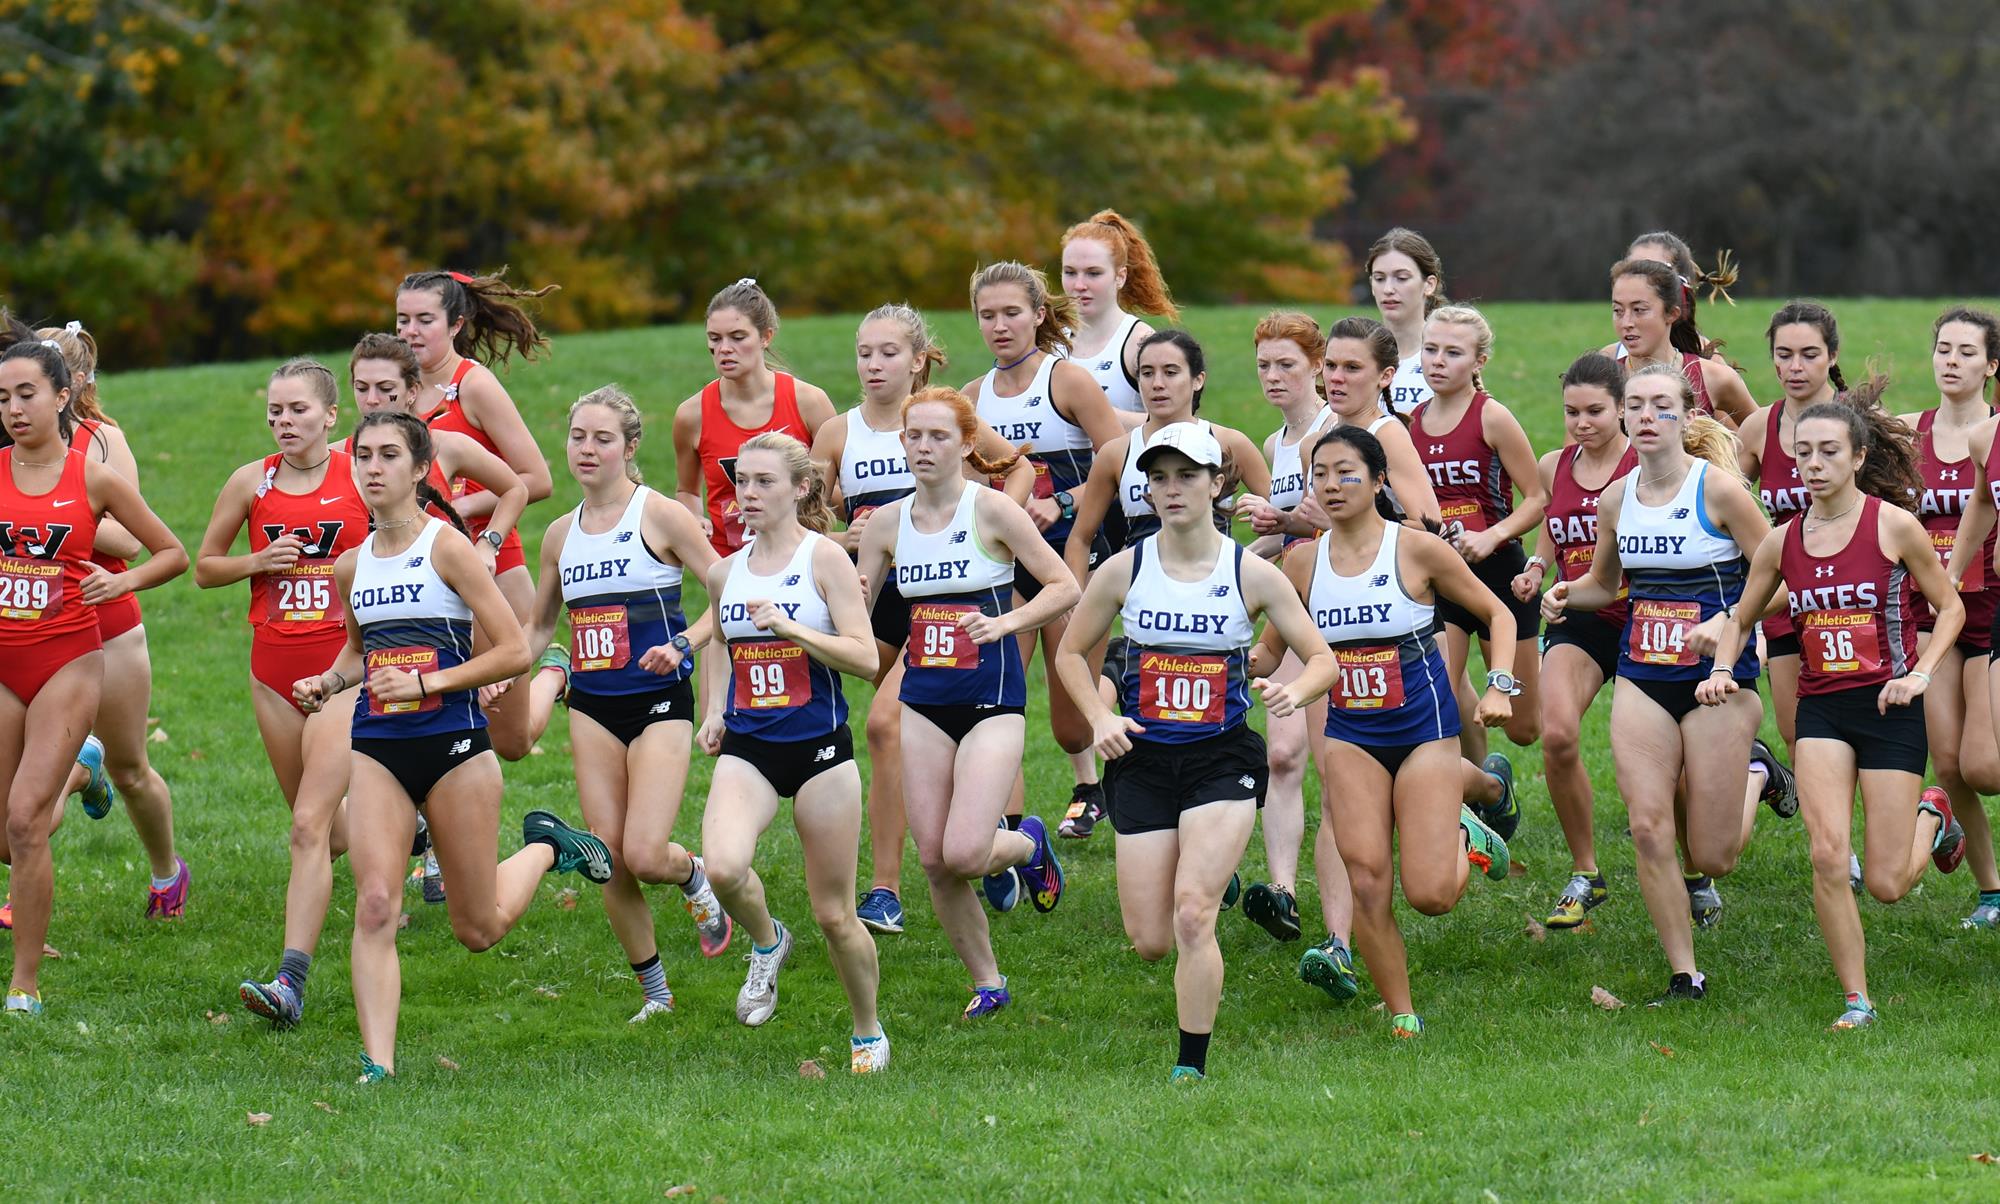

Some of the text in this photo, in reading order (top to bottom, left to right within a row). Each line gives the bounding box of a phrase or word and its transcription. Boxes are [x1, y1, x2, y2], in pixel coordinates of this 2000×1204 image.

[992, 421, 1042, 441] LBY
[855, 457, 911, 480] COL
[1270, 473, 1304, 496] OLBY
[1618, 536, 1686, 555] COLBY
[563, 559, 631, 586] COLBY
[900, 560, 970, 584] COLBY
[0, 577, 49, 609] 289
[279, 580, 330, 610] 295
[353, 584, 424, 610] COLBY
[1789, 582, 1878, 618] BATES
[721, 603, 800, 623] COY
[1139, 610, 1229, 634] COLBY
[1317, 603, 1392, 628] COLBY
[577, 627, 615, 659] 108
[924, 625, 955, 656] 95
[1640, 621, 1685, 652] 104
[1819, 630, 1854, 661] 36
[750, 663, 785, 696] 99
[1155, 677, 1211, 710] 100
[1341, 667, 1387, 698] 103
